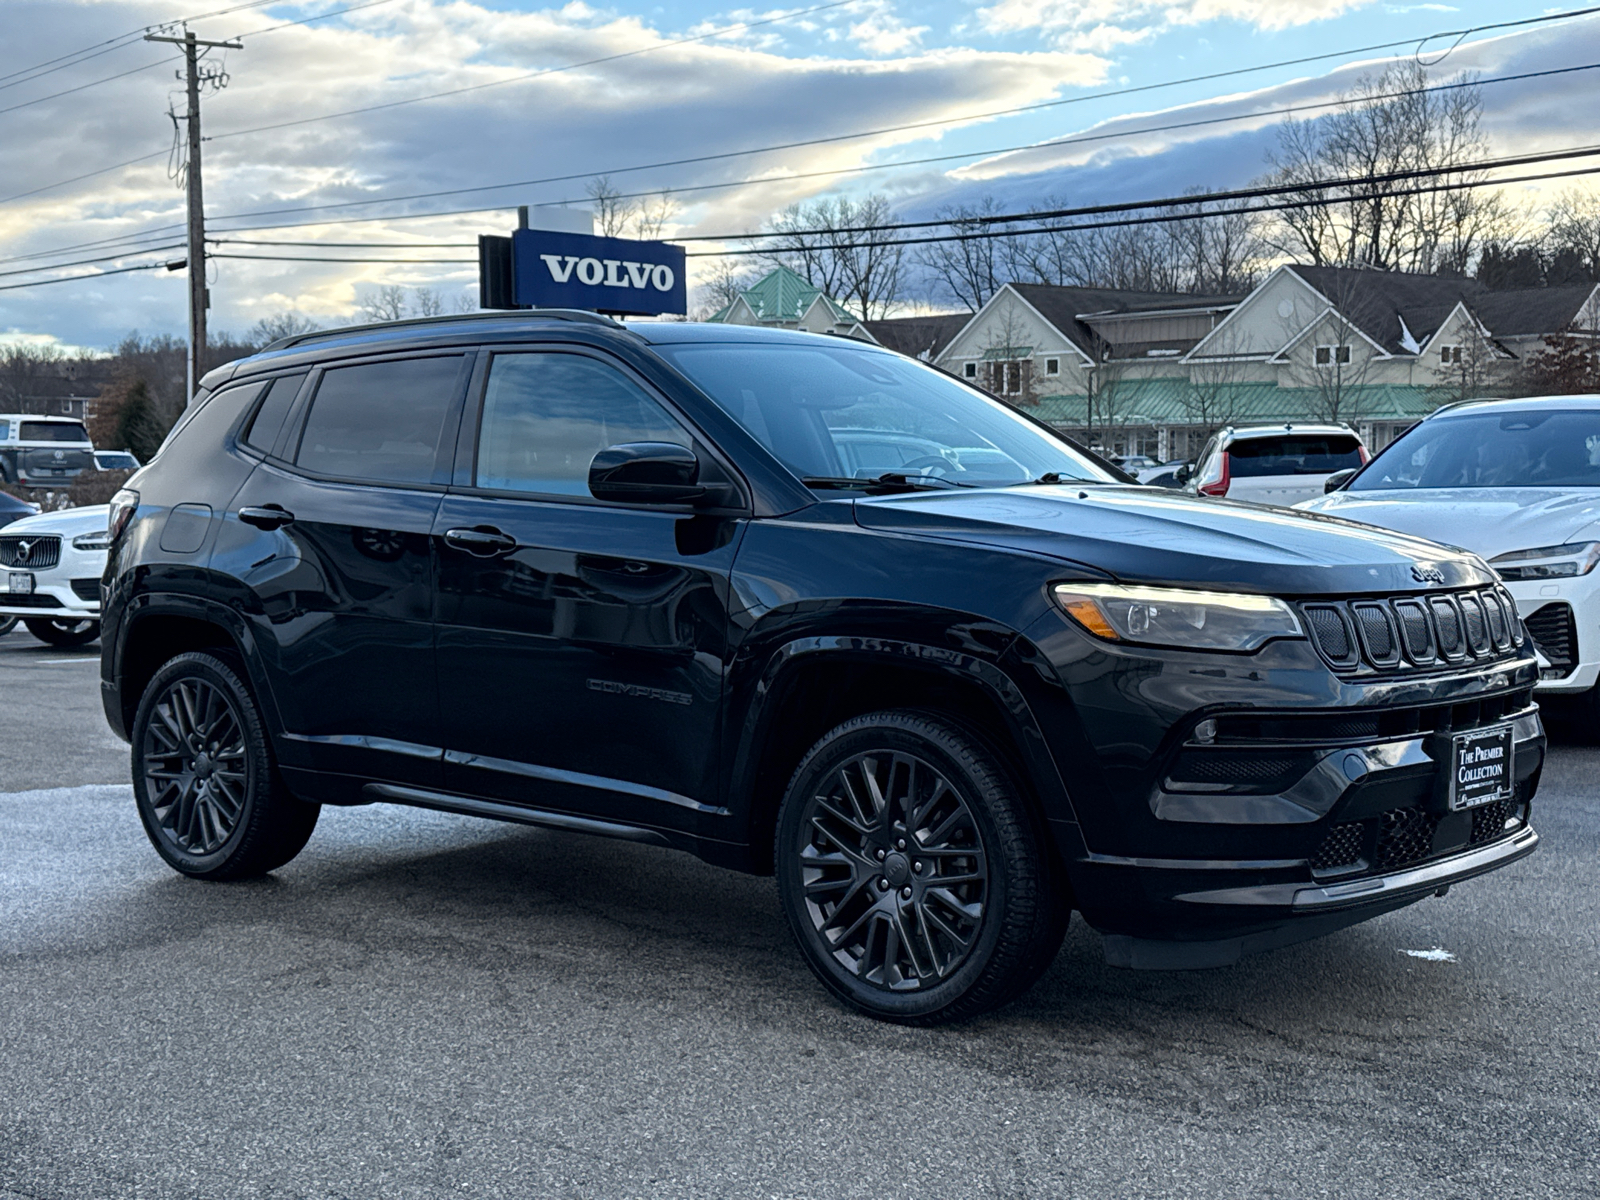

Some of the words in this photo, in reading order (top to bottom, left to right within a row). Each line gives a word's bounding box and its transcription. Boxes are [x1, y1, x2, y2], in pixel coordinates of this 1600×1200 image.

[540, 254, 675, 292] VOLVO
[1410, 566, 1445, 584] Jeep
[1459, 749, 1474, 765] THE
[1474, 746, 1504, 762] PREMIER
[1458, 763, 1503, 784] COLLECTION
